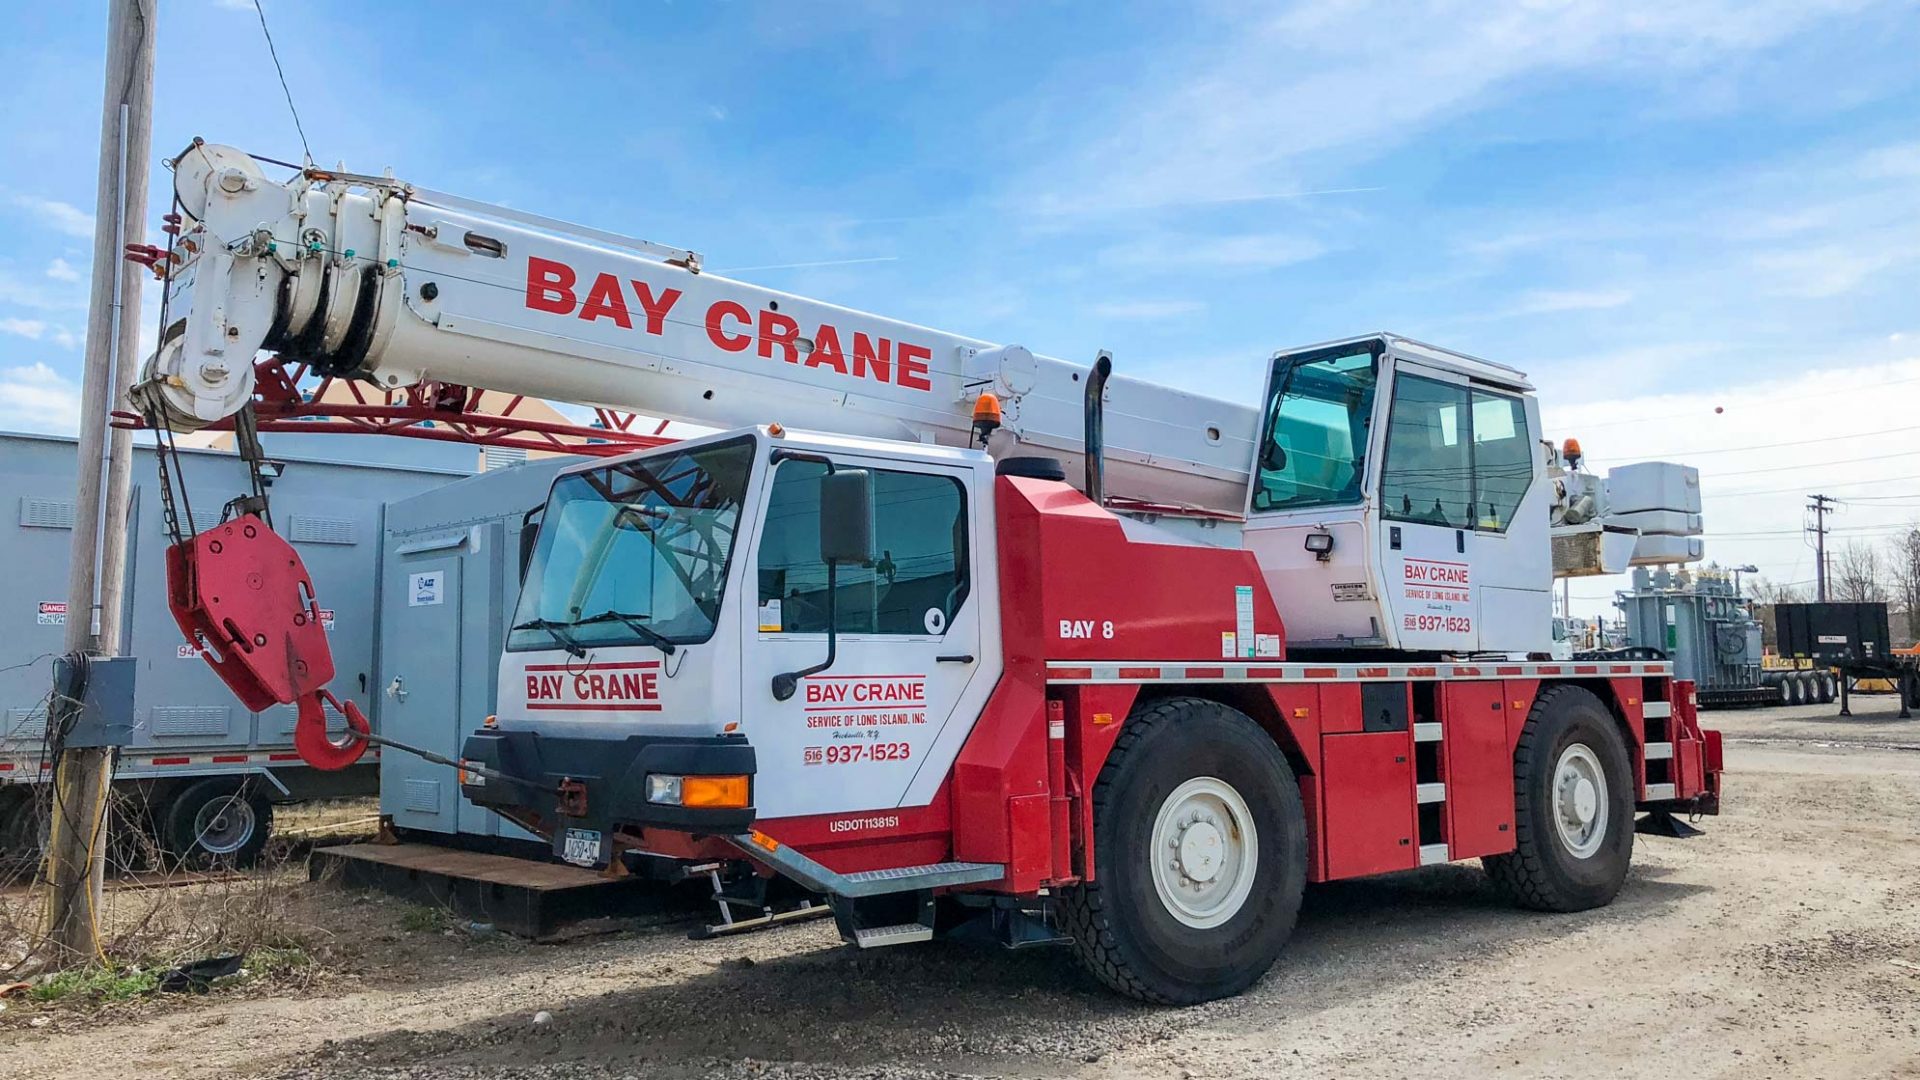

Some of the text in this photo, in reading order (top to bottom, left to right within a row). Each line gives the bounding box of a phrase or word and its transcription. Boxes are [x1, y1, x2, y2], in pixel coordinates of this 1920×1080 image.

[525, 255, 932, 392] BAY CRANE
[1404, 564, 1469, 584] BAY CRANE
[1405, 588, 1425, 599] SERVICE
[42, 603, 67, 612] DANGE
[1059, 619, 1114, 639] BAY 8
[1418, 615, 1471, 633] 937-1523
[526, 673, 659, 701] BAY CRANE
[806, 682, 925, 703] BAY CRANE
[807, 715, 841, 729] SERVICE
[844, 715, 854, 727] OF
[857, 714, 877, 727] LONG
[912, 712, 928, 724] INC.
[804, 742, 911, 764] 516 937-1523
[829, 816, 900, 833] USDOT1138151
